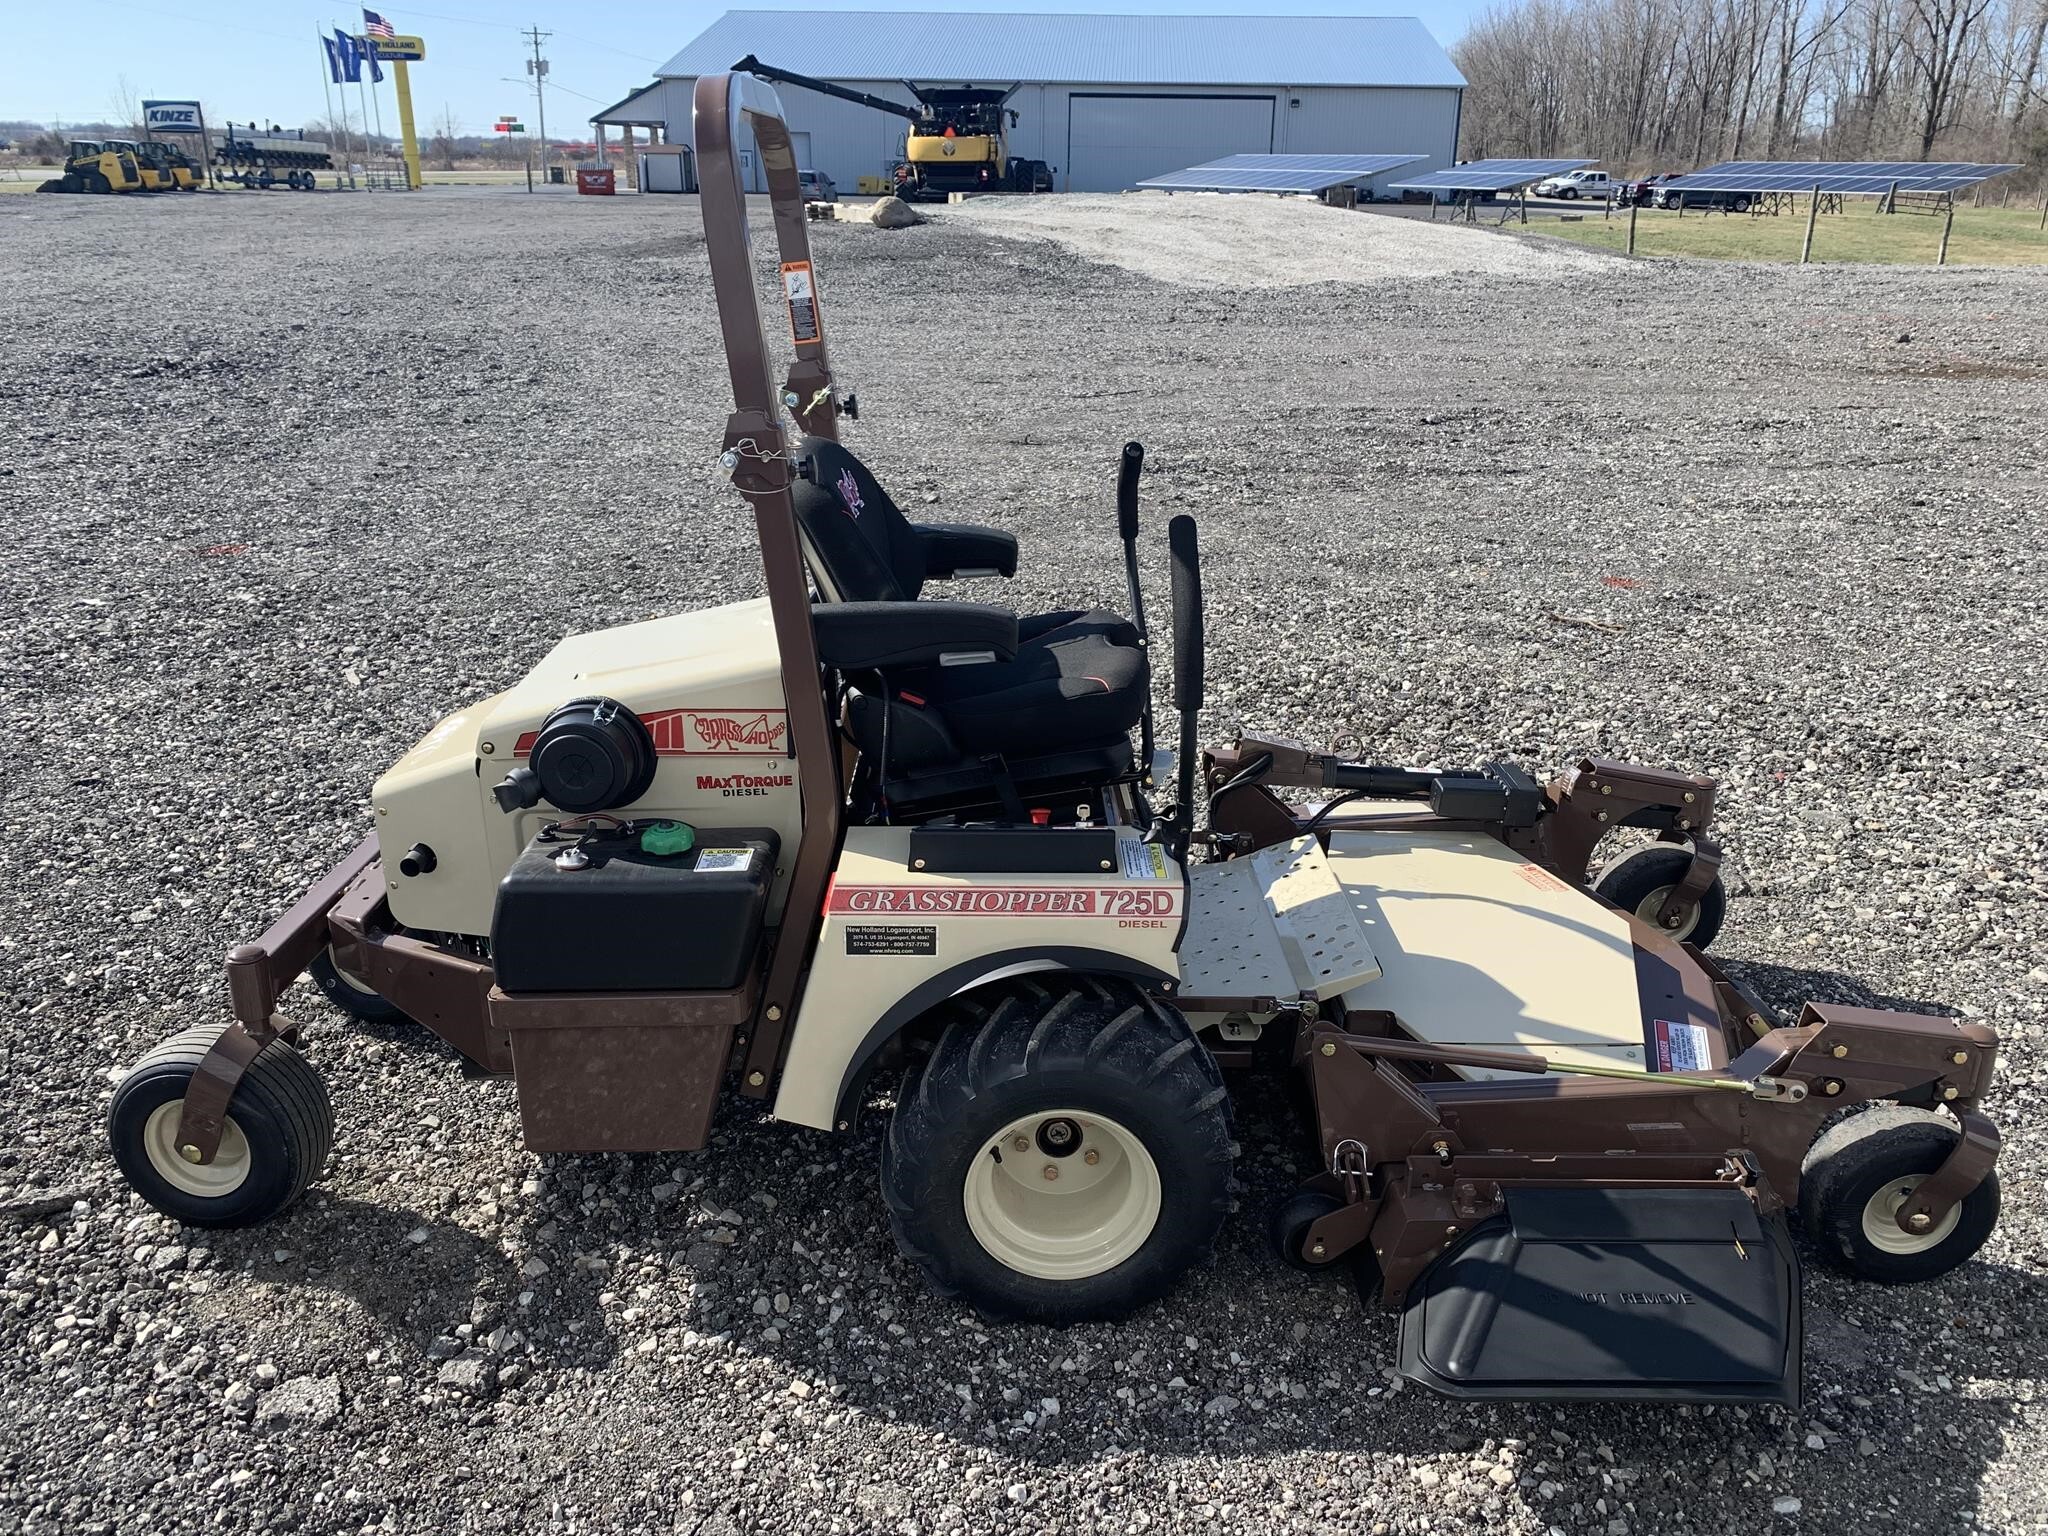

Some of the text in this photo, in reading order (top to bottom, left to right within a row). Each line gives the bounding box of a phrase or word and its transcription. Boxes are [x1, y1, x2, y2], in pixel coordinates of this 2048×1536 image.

[382, 41, 416, 49] HOLLAND
[149, 110, 194, 122] KINZE
[723, 788, 768, 797] DIESEL
[848, 890, 1174, 915] GRASSHOPPER 725D
[1118, 920, 1167, 929] DIESEL
[886, 926, 923, 935] Logansport,
[1660, 1040, 1671, 1062] DANGER
[1572, 1292, 1608, 1305] NOT
[1619, 1292, 1697, 1305] REMOVE
